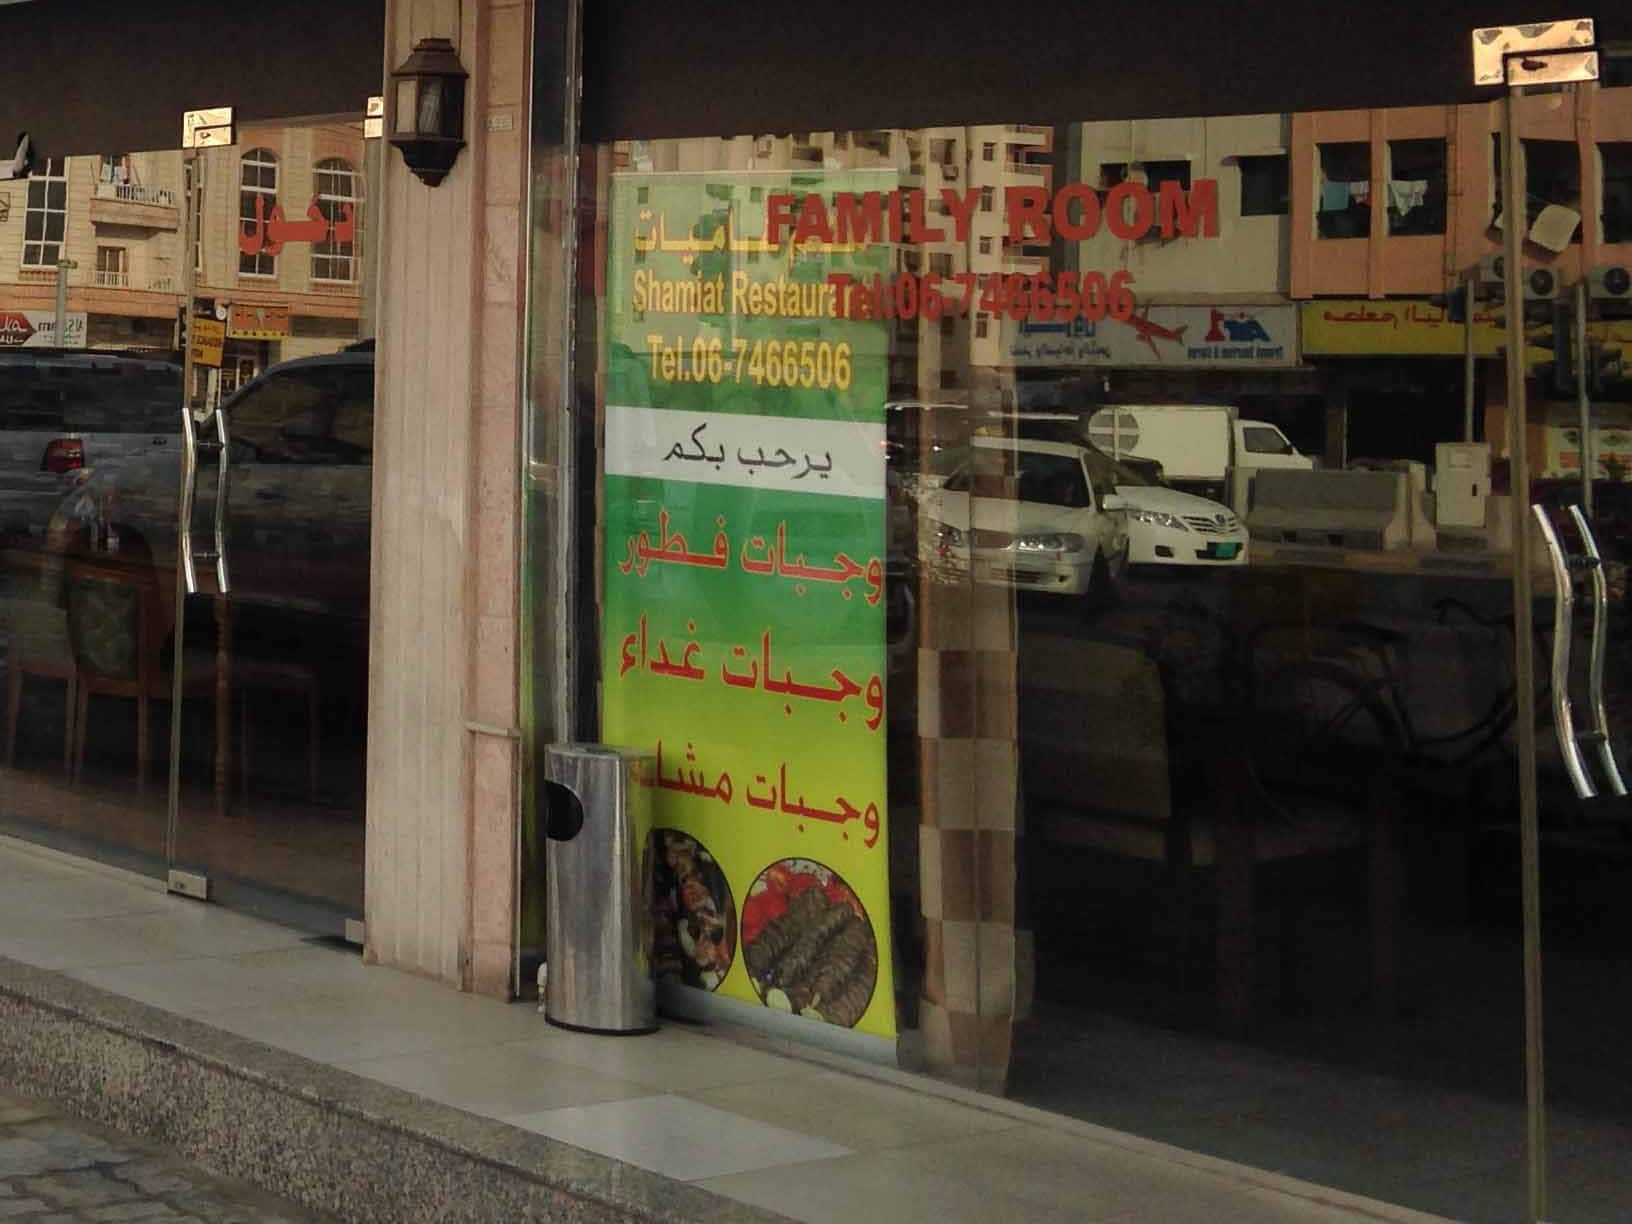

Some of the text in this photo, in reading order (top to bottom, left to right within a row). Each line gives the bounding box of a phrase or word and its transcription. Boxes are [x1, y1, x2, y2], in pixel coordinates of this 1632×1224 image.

[240, 192, 355, 256] دخول
[767, 179, 1220, 245] FAMILY ROOM
[633, 272, 726, 315] Shamiat
[647, 333, 852, 392] Tel.06-7466506
[662, 422, 833, 480] يرحب بكم
[617, 511, 884, 605] وجبات فطور
[618, 610, 884, 731] وجبات غداء
[655, 739, 881, 849] وجبات مشا
